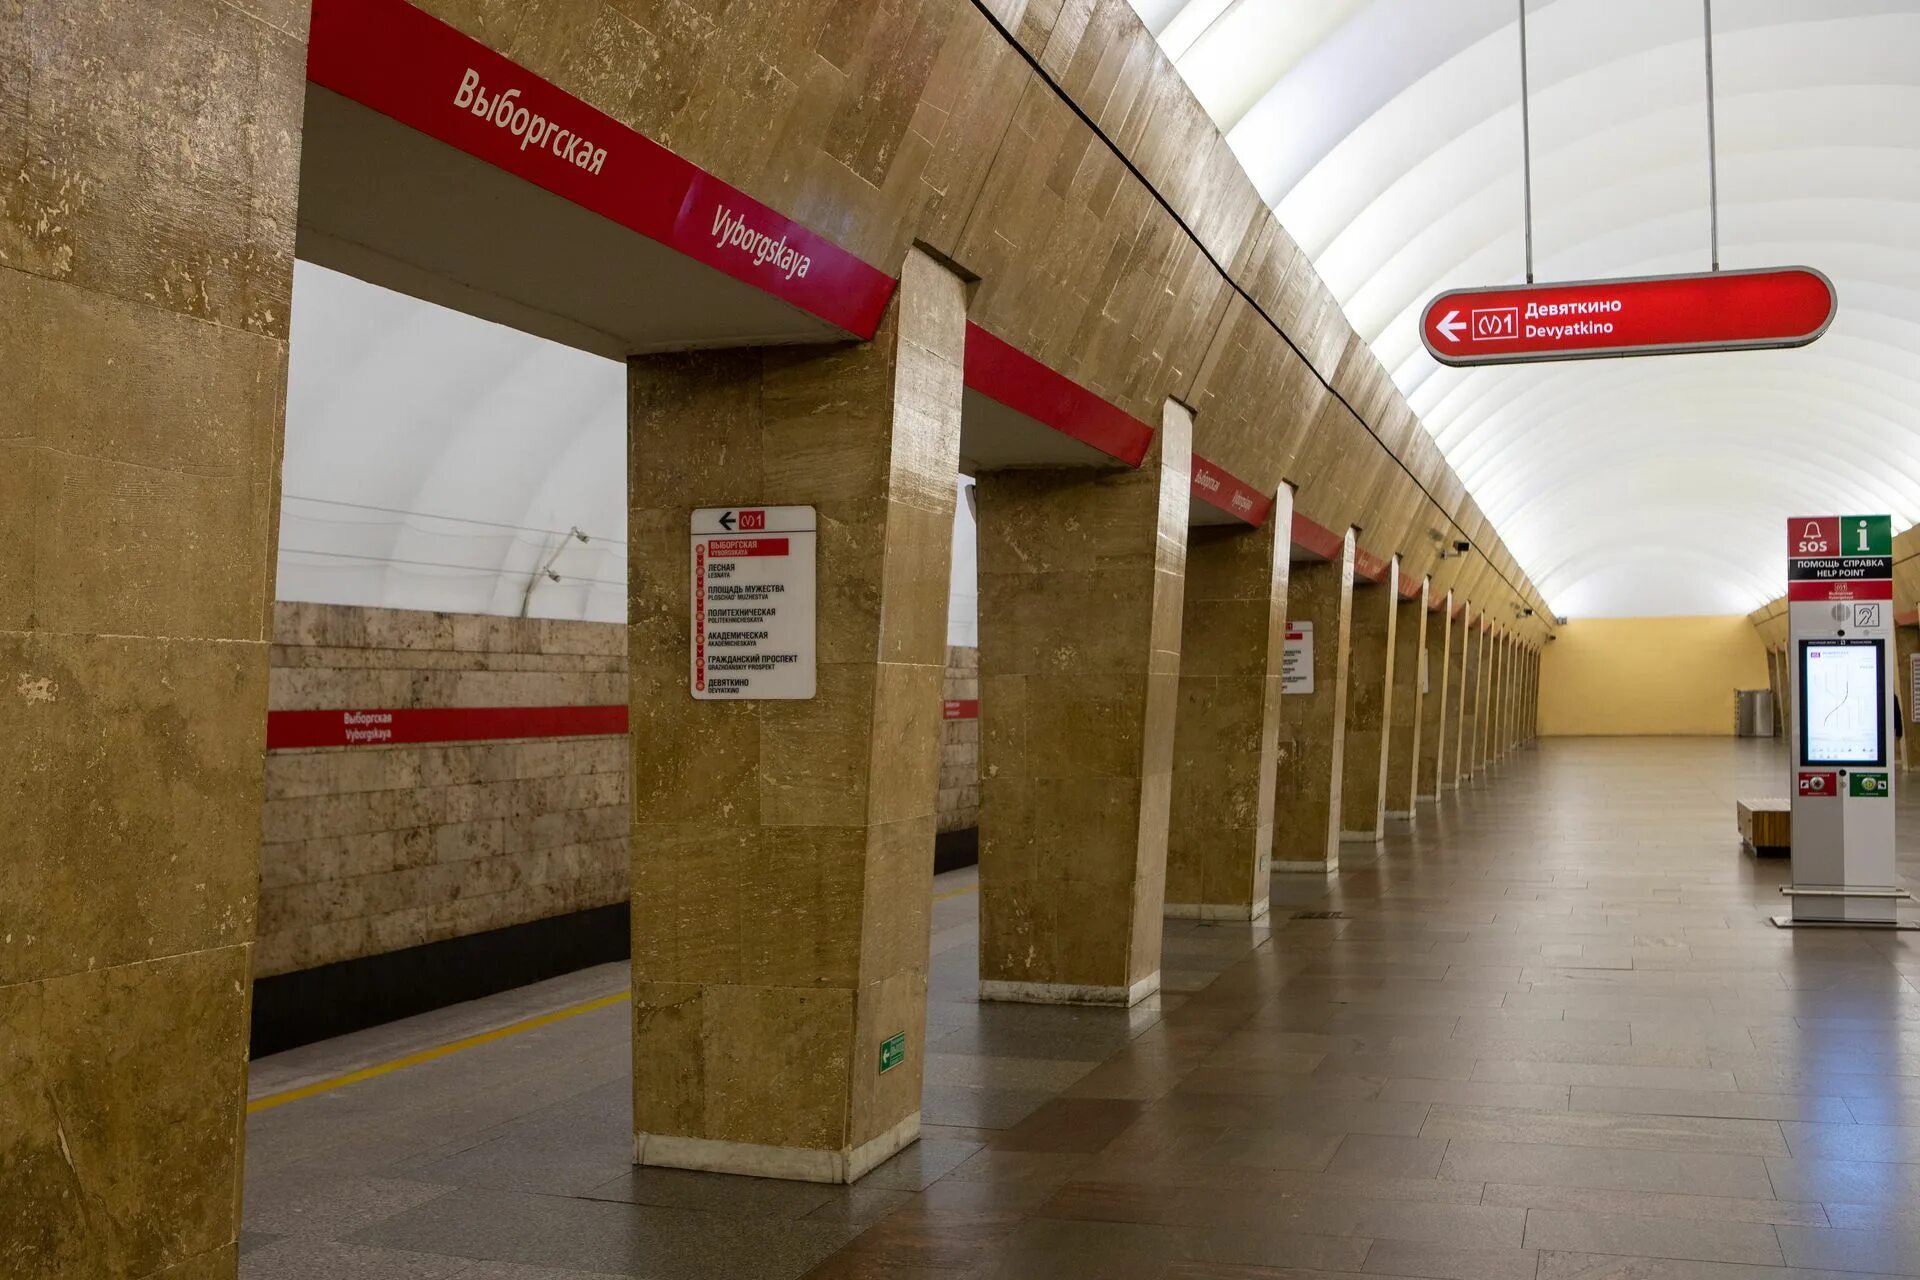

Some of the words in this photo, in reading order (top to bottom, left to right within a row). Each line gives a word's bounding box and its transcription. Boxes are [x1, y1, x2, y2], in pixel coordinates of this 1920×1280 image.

[453, 67, 609, 176] Выборгская
[710, 204, 812, 280] Vyborgskaya
[1525, 300, 1622, 320] Девяткино
[1525, 321, 1614, 340] Devyatkino
[710, 541, 758, 549] ВЫБОРГСКАЯ
[1798, 541, 1828, 552] SOS
[1797, 561, 1840, 569] ПОМОЩЬ
[1843, 559, 1884, 567] СПРАВКА
[1839, 569, 1865, 577] POINT
[708, 586, 743, 594] ПЛОЩАДЬ
[745, 584, 785, 593] МУЖЕСТВА
[708, 608, 776, 617] ПОЛИТЕХНИЧЕСКАЯ
[708, 632, 768, 640] АКАДЕМИЧЕСКАЯ
[708, 654, 760, 663] ГРАЖДАНСКИЙ
[761, 655, 798, 663] ПРОСПЕКТ
[708, 679, 749, 687] ДЕВЯТКИНО
[343, 711, 393, 727] Выборгская
